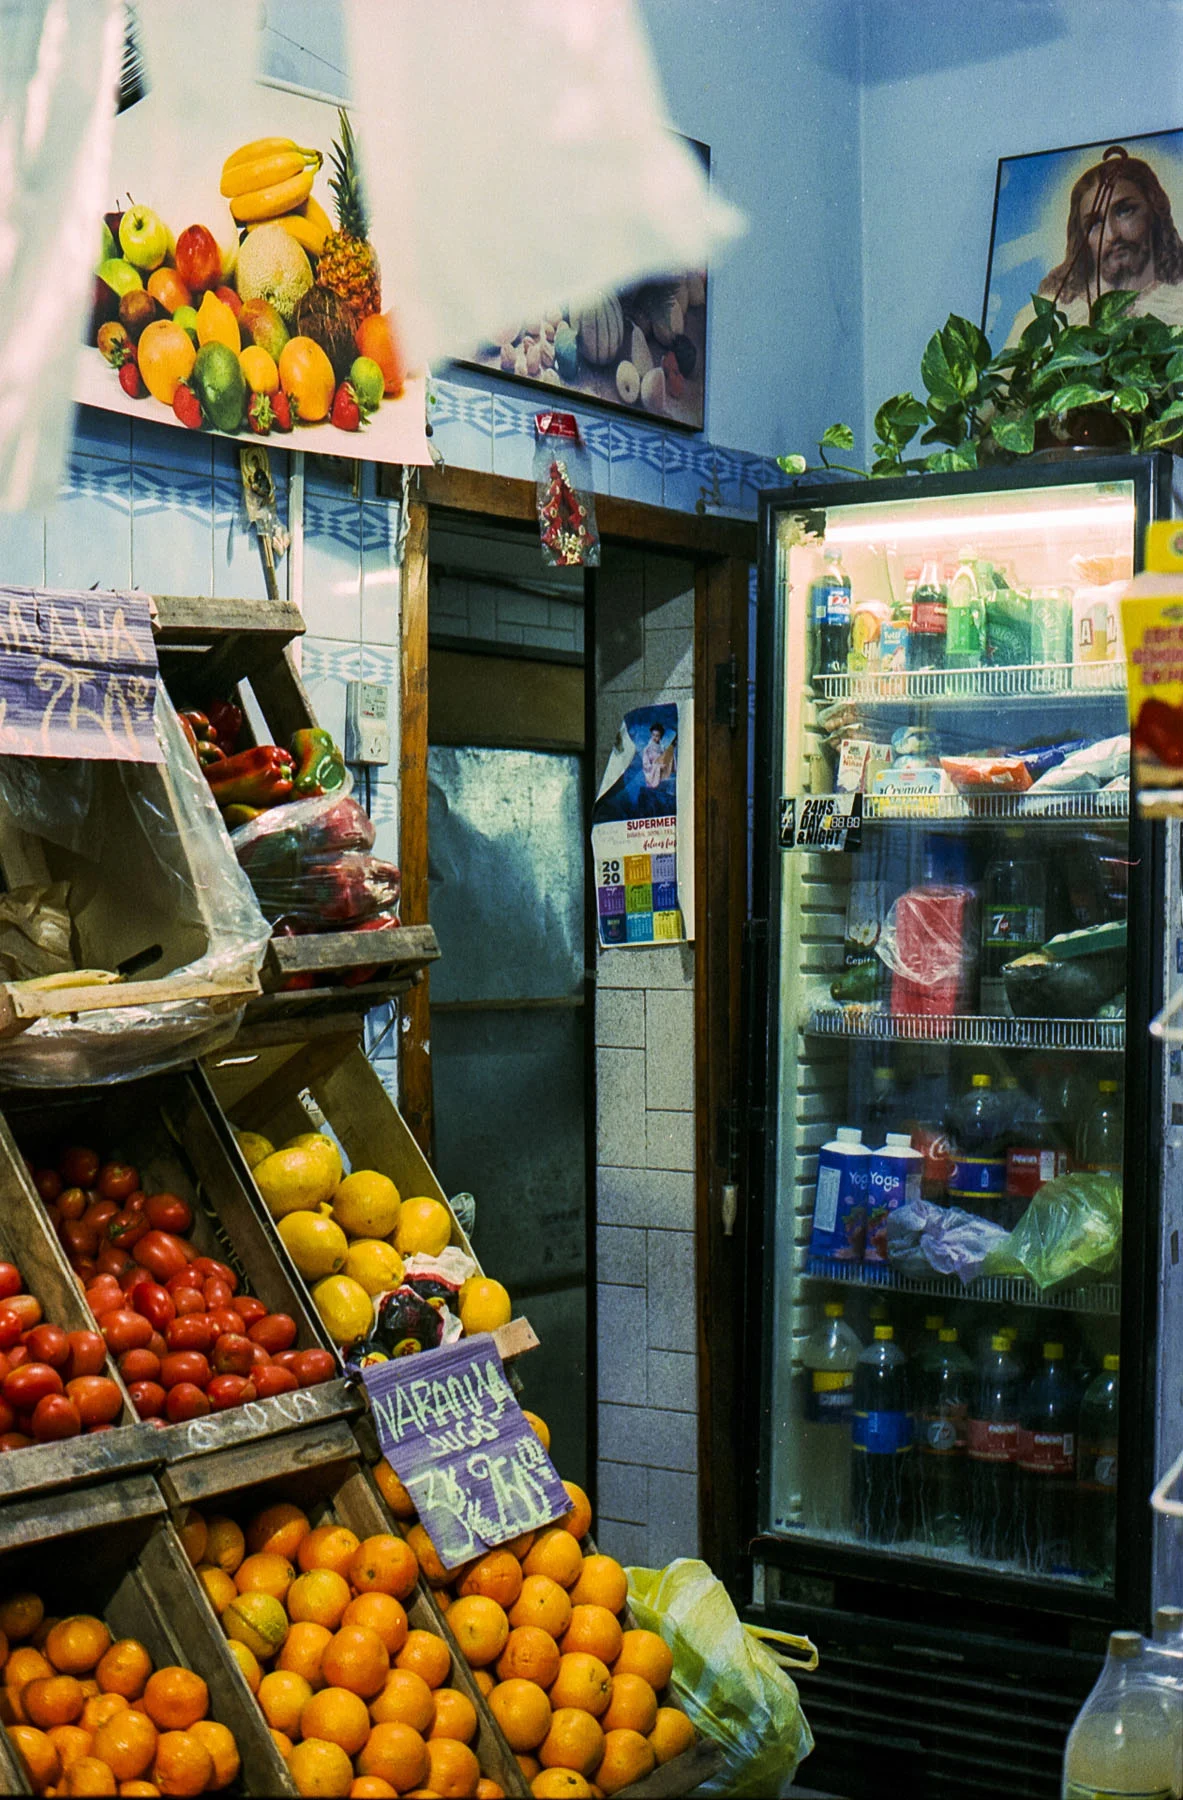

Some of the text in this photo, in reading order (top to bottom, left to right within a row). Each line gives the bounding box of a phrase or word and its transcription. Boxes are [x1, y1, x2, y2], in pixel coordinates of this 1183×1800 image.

[803, 799, 835, 815] 24HS
[799, 814, 824, 830] DAY
[602, 861, 620, 873] 20
[603, 873, 621, 885] 20
[869, 1171, 900, 1192] Yogs
